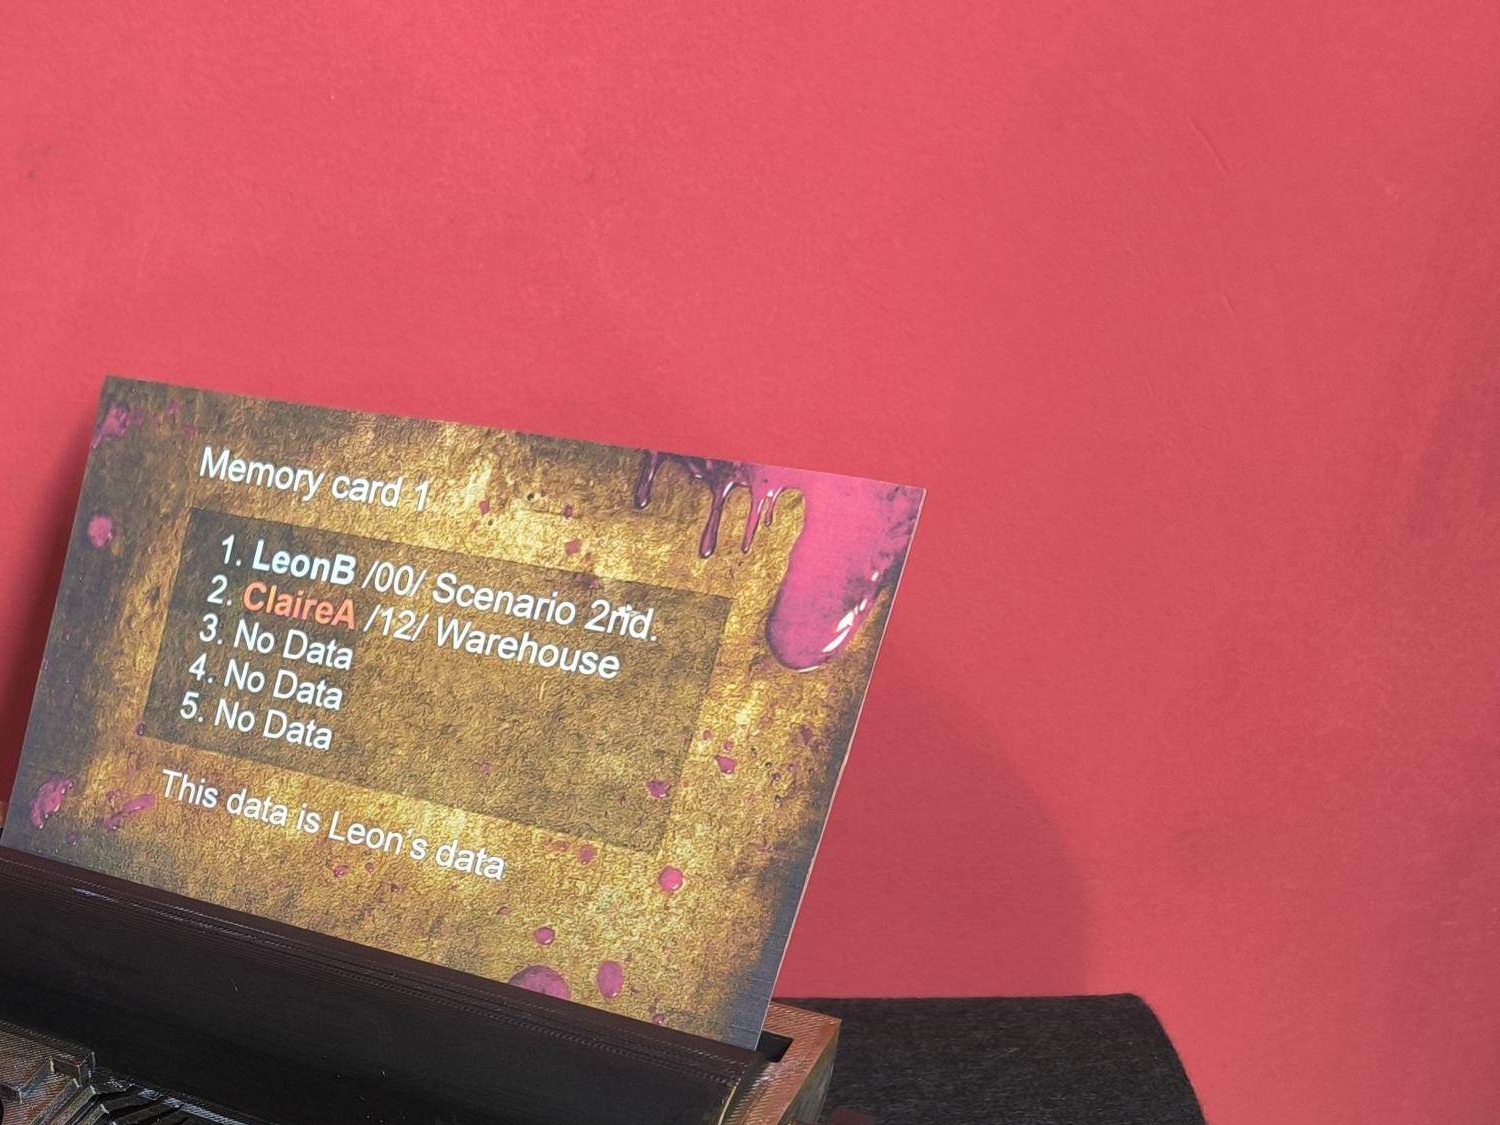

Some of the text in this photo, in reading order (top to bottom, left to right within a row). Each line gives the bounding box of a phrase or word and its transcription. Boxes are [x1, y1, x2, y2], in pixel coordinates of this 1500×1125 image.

[199, 446, 430, 511] Memory card 1
[221, 534, 659, 642] 1. LeonB /00/ Scenario 2nd.
[199, 613, 353, 671] 3. No Data
[207, 574, 621, 680] 2. ClaireA /12/ Warehouse
[189, 652, 343, 711] 4. No Data
[179, 691, 332, 750] 5. No Data
[162, 768, 506, 880] This data is Leon's data
